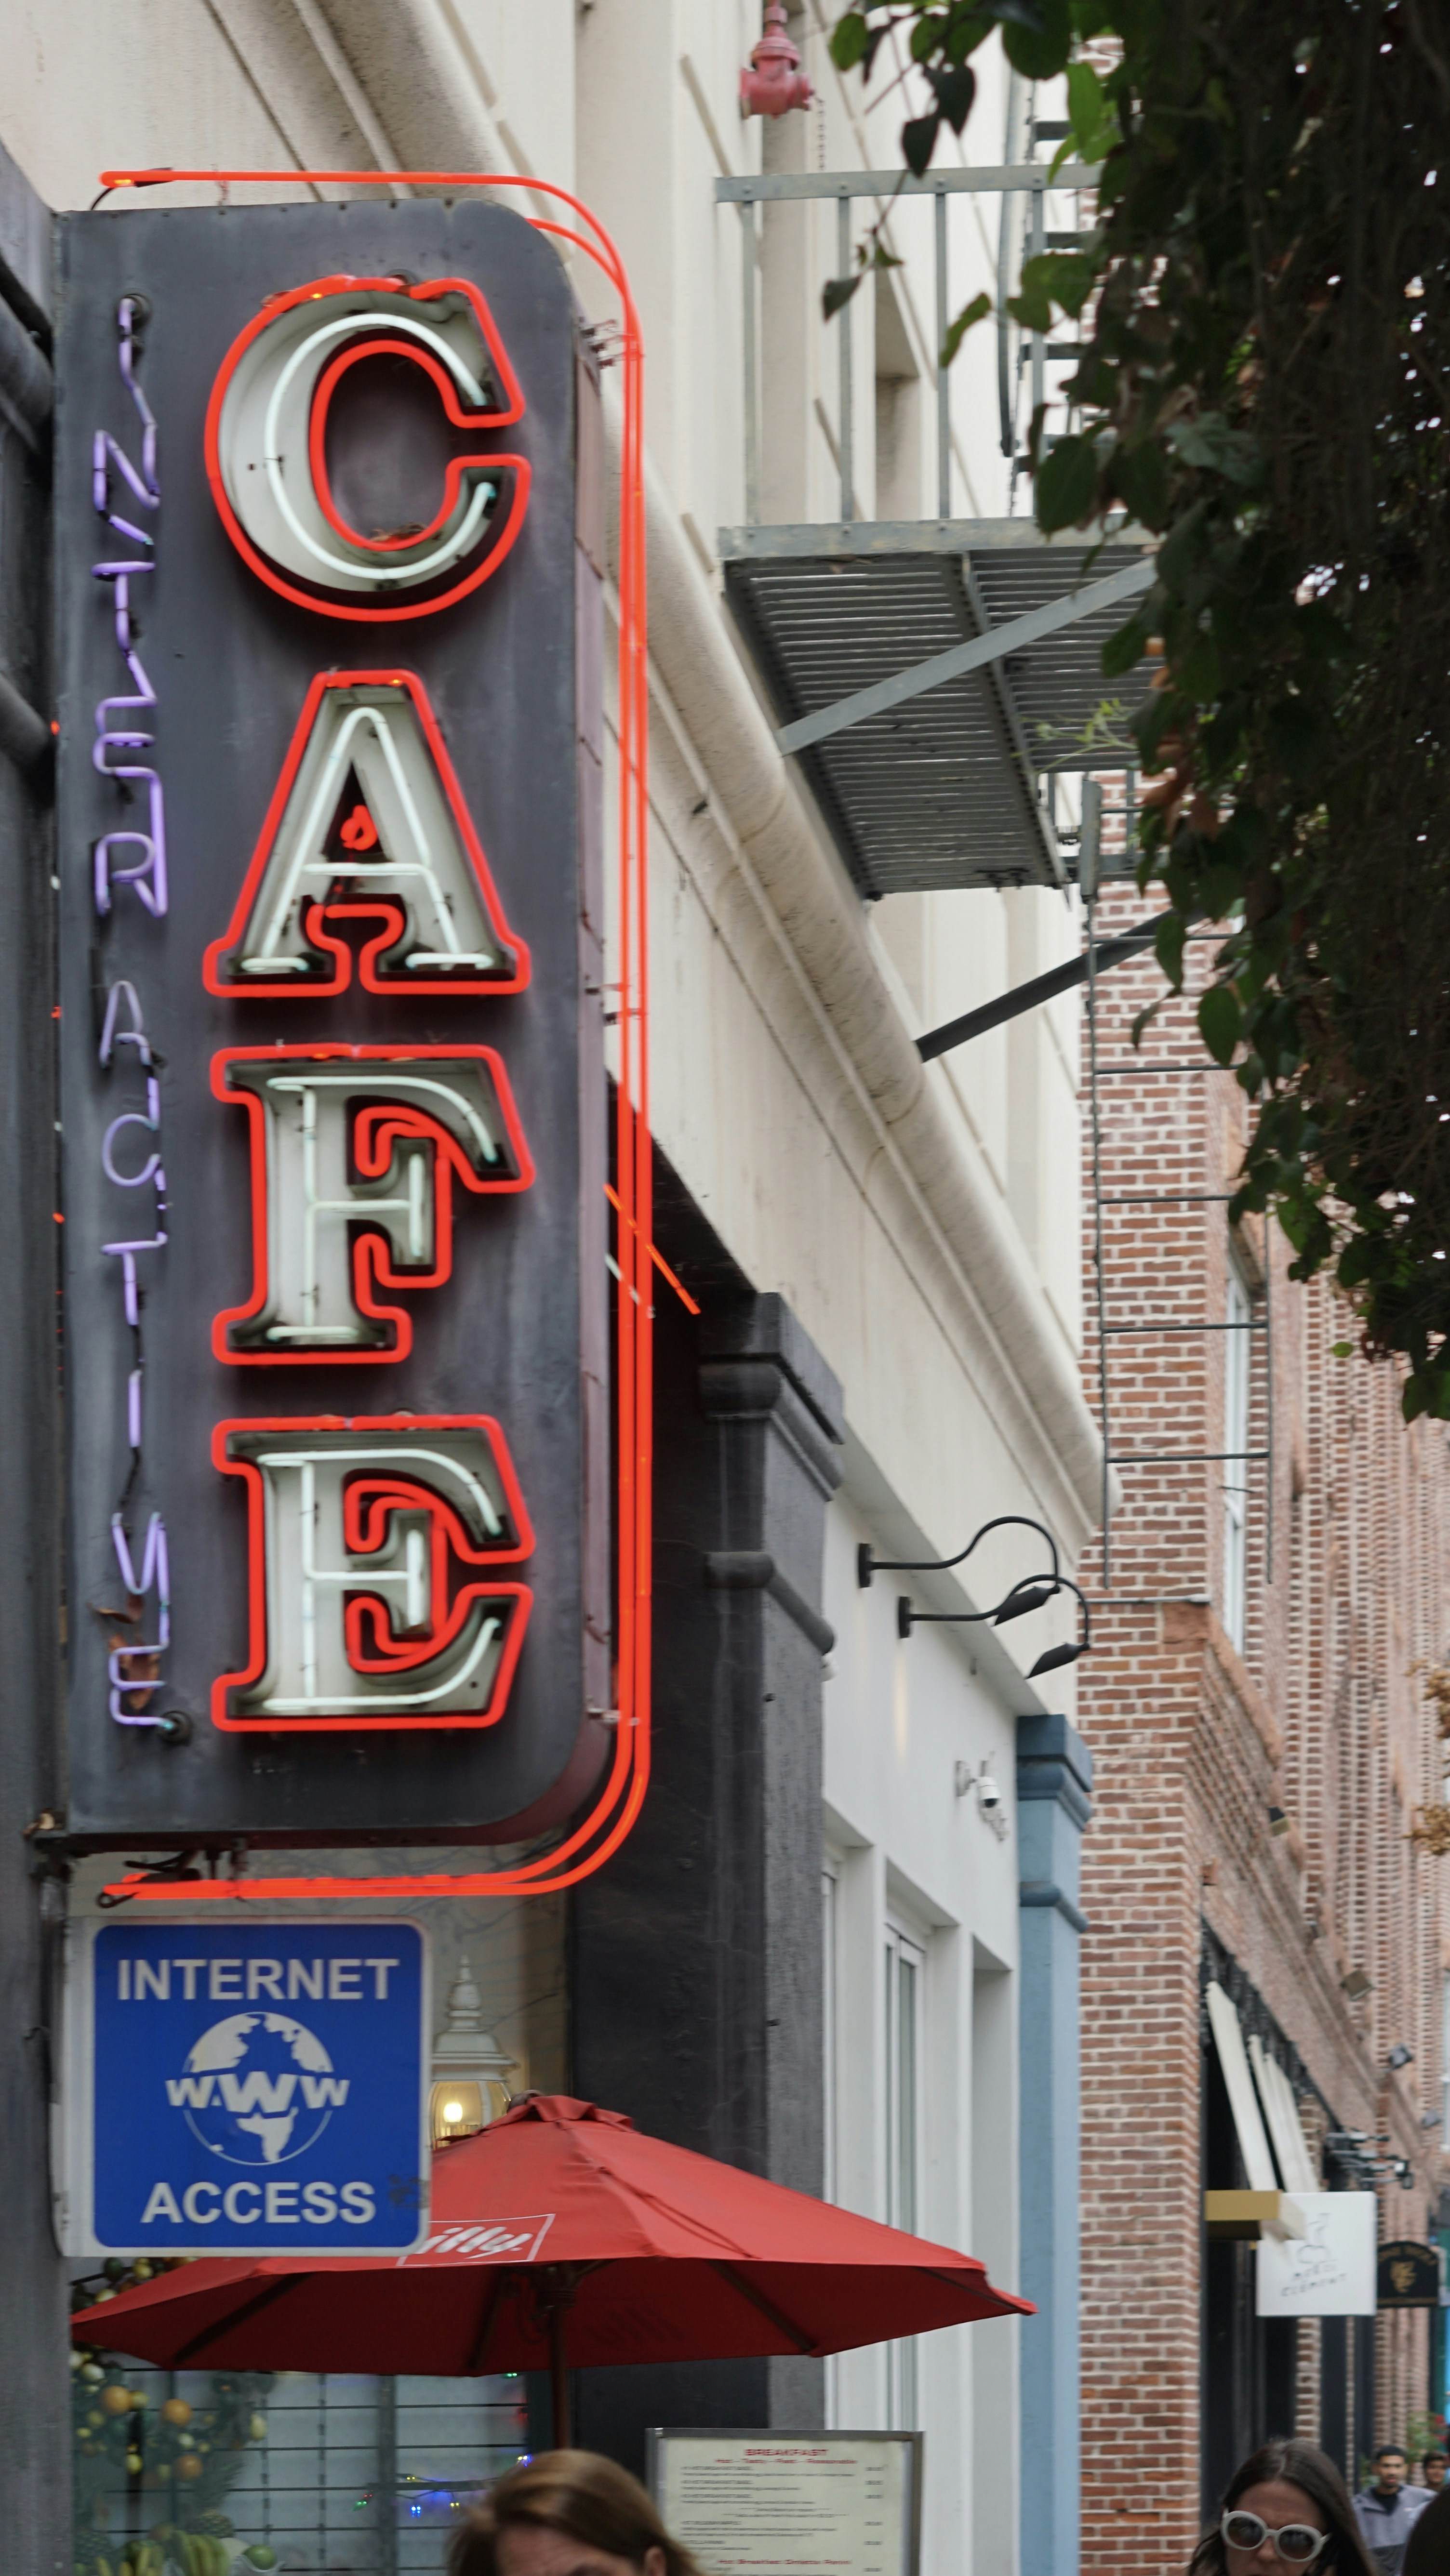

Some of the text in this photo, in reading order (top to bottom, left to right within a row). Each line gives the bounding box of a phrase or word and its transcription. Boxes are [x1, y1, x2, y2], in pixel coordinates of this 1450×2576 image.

[204, 274, 536, 1731] CAFE
[118, 1958, 399, 2000] INTERNET
[165, 2071, 350, 2114] WWW
[140, 2182, 376, 2224] ACCESS
